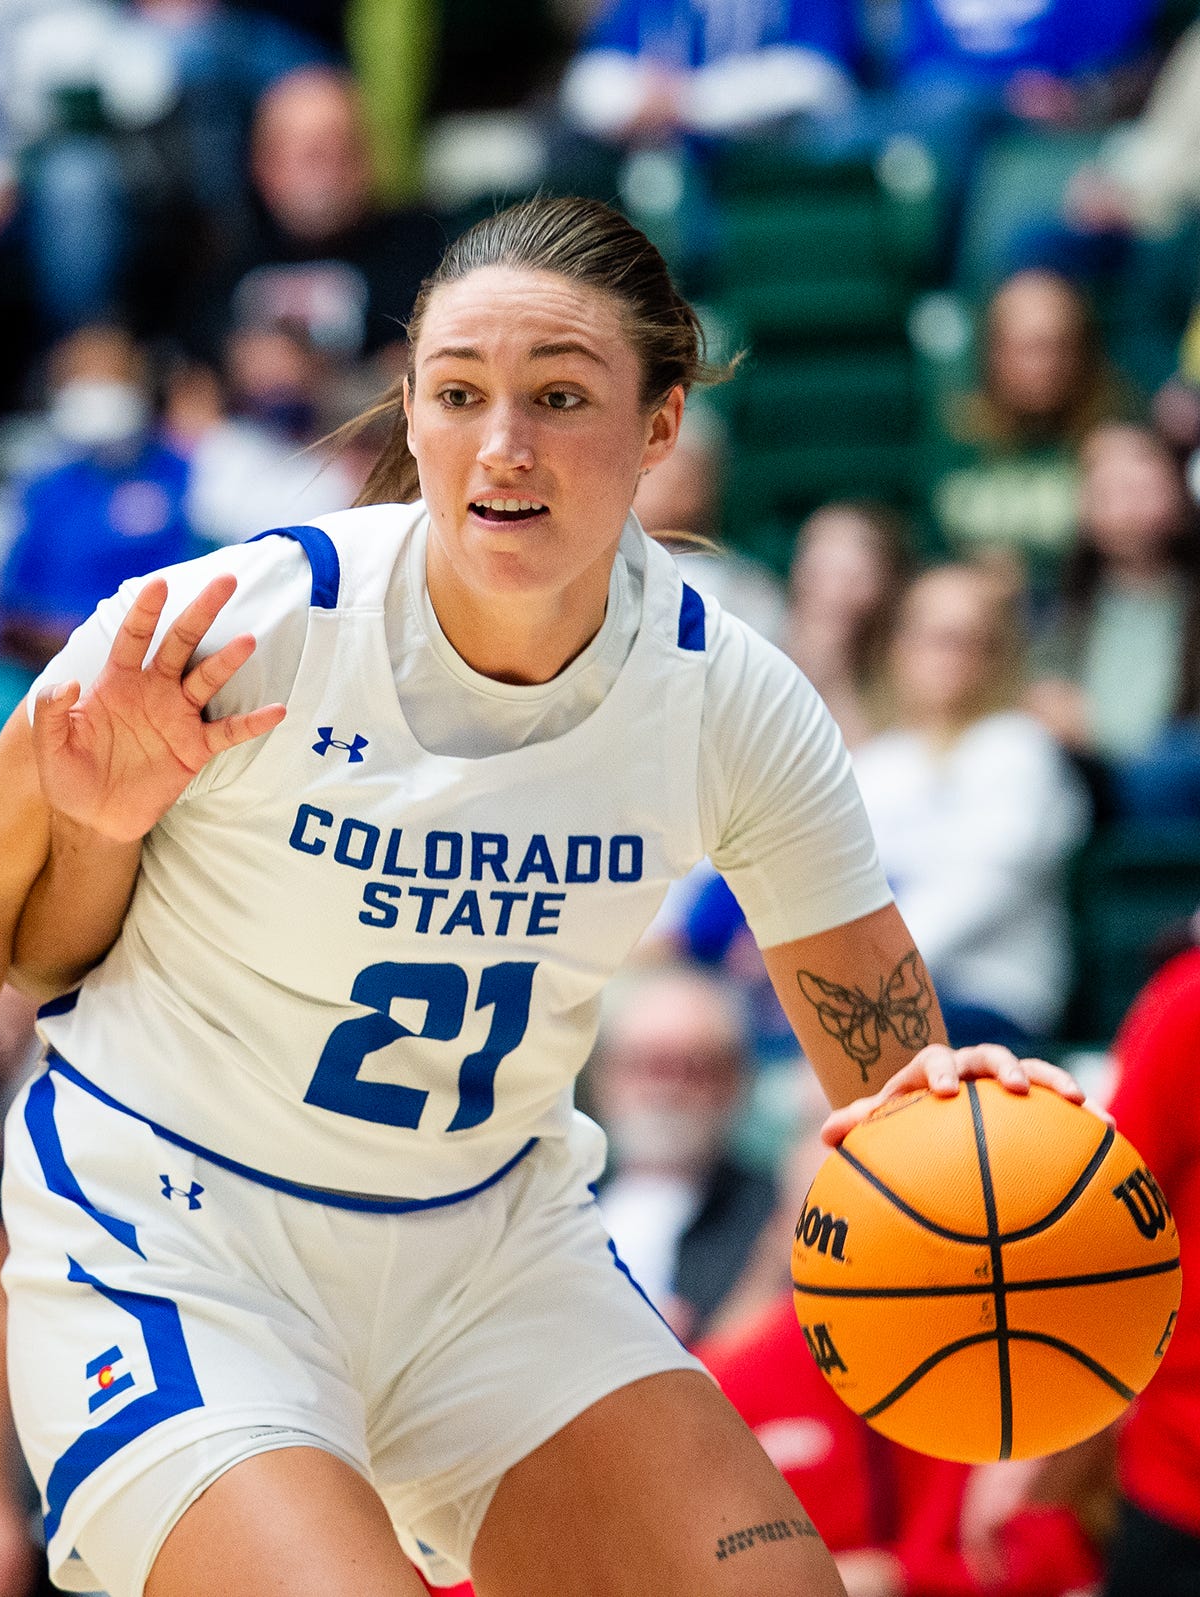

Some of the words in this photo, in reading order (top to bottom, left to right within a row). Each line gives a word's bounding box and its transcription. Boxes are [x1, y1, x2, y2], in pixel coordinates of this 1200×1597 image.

[289, 803, 644, 884] COLORADO
[358, 881, 567, 936] STATE
[303, 961, 540, 1133] 21
